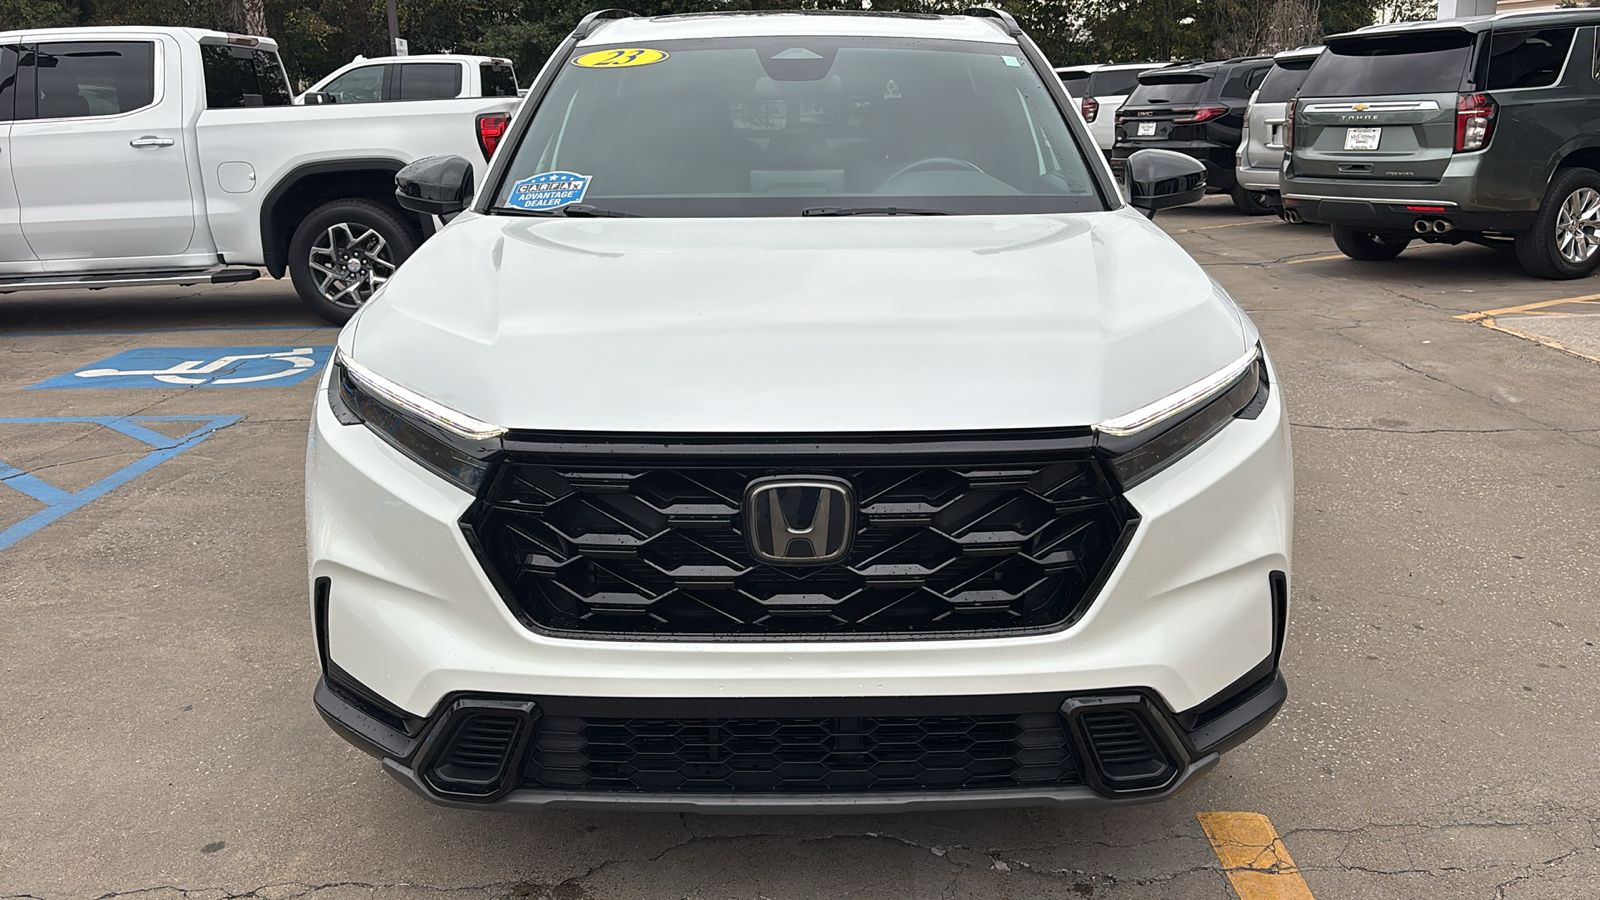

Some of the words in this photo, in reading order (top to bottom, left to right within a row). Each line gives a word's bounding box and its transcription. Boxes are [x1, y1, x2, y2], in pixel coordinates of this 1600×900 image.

[592, 50, 645, 66] 23
[518, 182, 582, 193] CARFAX
[517, 191, 574, 201] ADVANTAGE
[524, 199, 562, 208] DEALER
